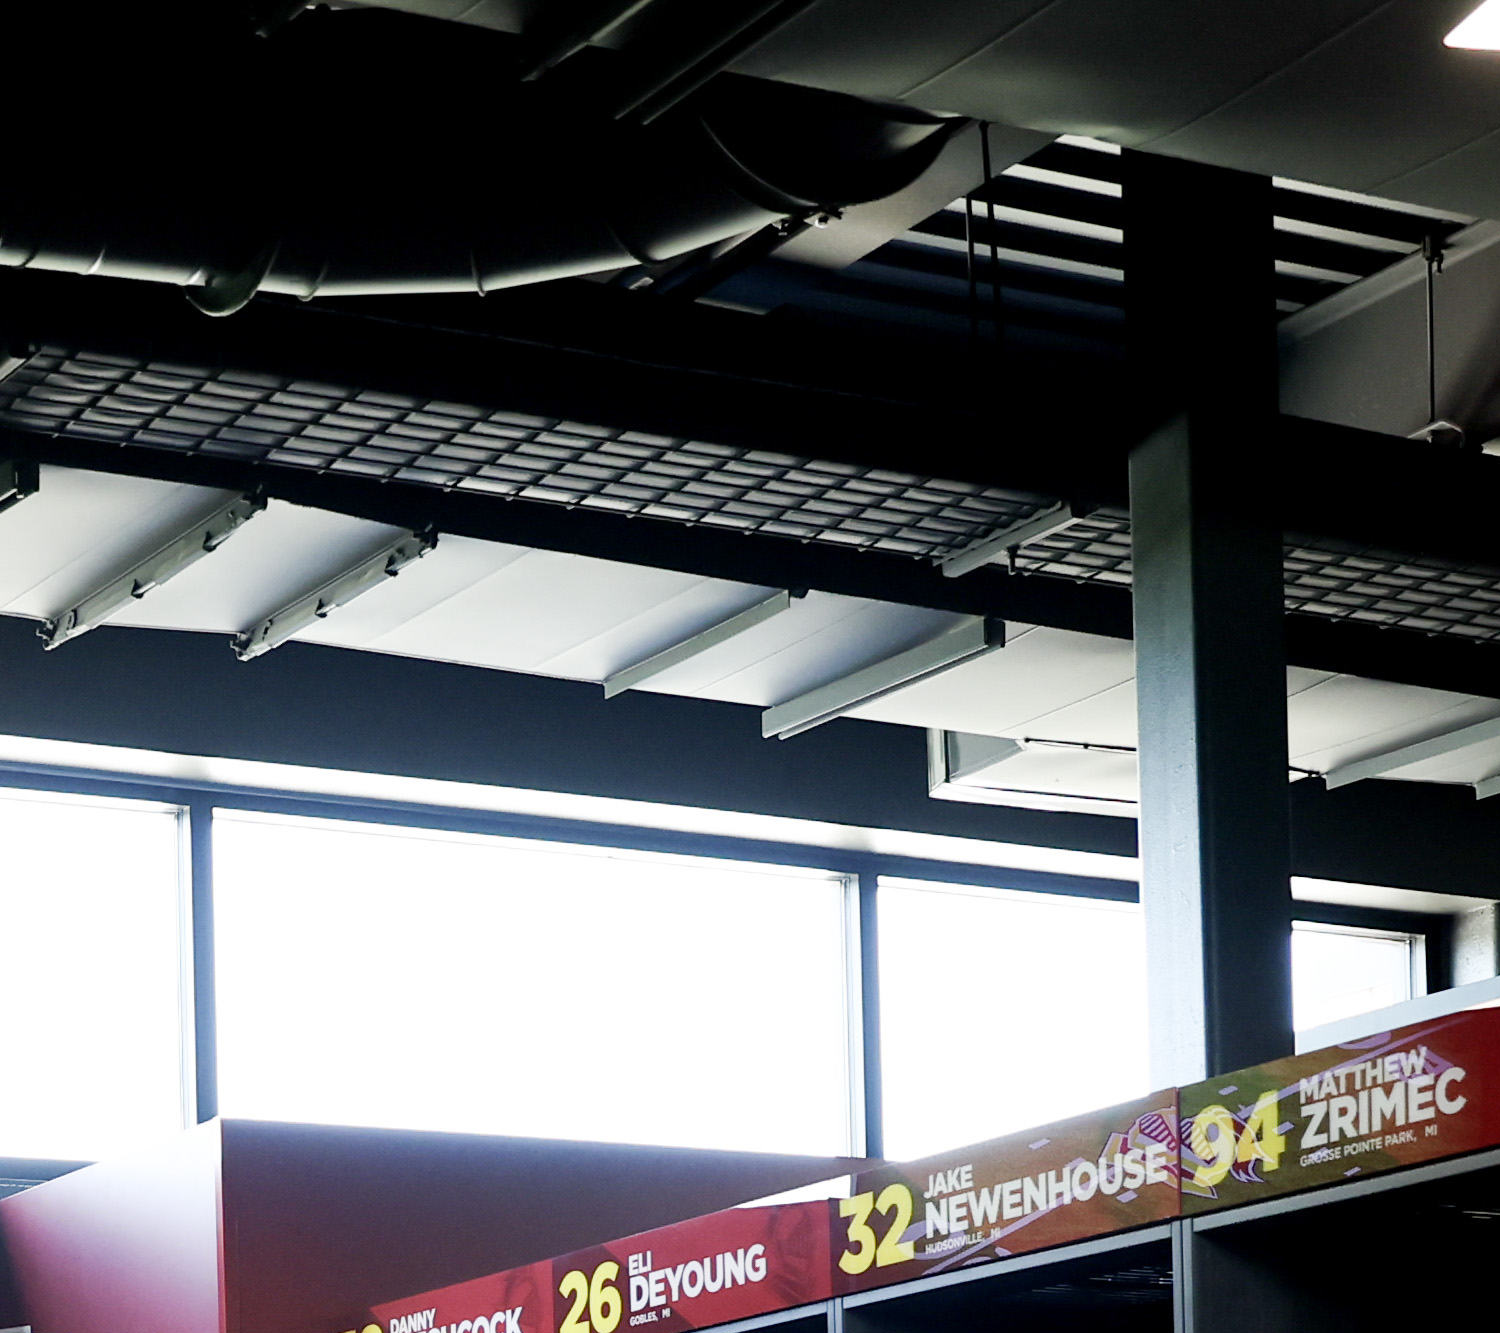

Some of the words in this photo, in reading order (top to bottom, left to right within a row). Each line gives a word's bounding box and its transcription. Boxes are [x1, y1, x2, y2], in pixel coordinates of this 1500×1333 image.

[1300, 1045, 1427, 1104] MATTHEW
[1190, 1089, 1286, 1188] 94
[1300, 1067, 1467, 1150] ZRIMEC
[1300, 1147, 1341, 1168] GROSSE
[1344, 1138, 1383, 1157] POINTE
[1385, 1130, 1417, 1147] PARK,
[1425, 1124, 1438, 1136] MI
[924, 1164, 973, 1199] JAKE
[925, 1143, 1169, 1239] NEWENHOUSE
[838, 1183, 916, 1275] 32
[628, 1250, 652, 1277] ELI
[629, 1243, 767, 1313] DEYOUNG
[629, 1310, 658, 1327] GOBLES,
[661, 1308, 671, 1320] MI
